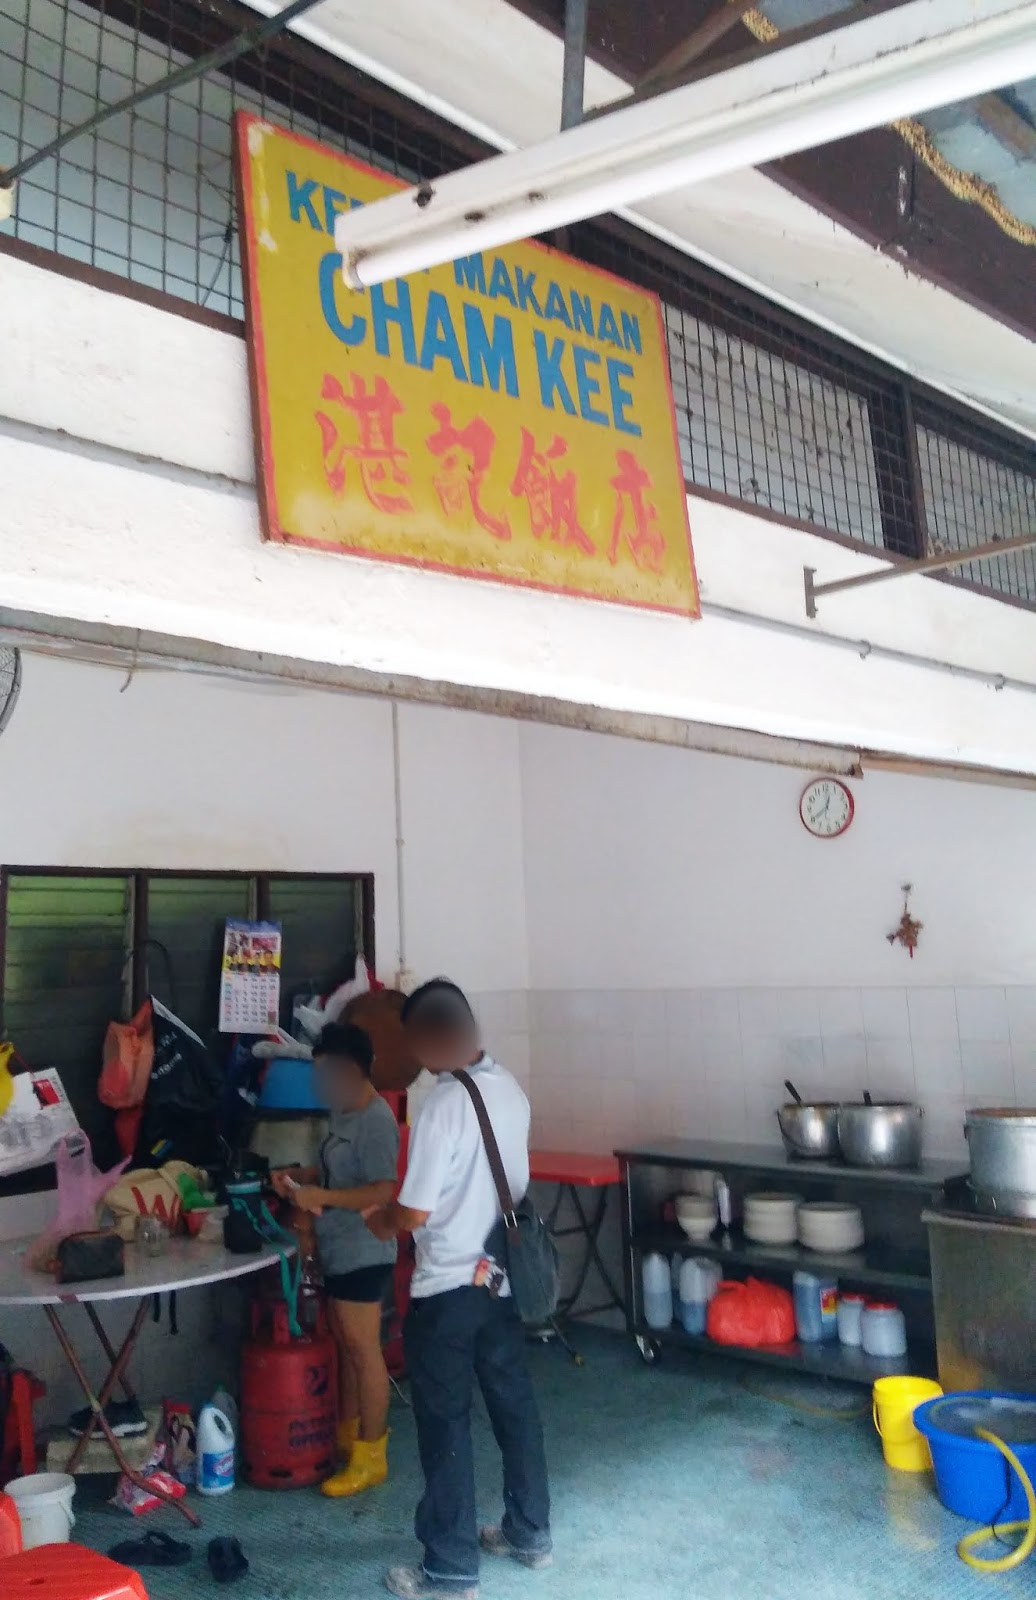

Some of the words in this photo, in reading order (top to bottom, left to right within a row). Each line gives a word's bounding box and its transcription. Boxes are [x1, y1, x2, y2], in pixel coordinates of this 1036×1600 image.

[319, 252, 519, 398] CHAM
[534, 328, 641, 436] KEE
[453, 252, 642, 354] MAKANAN
